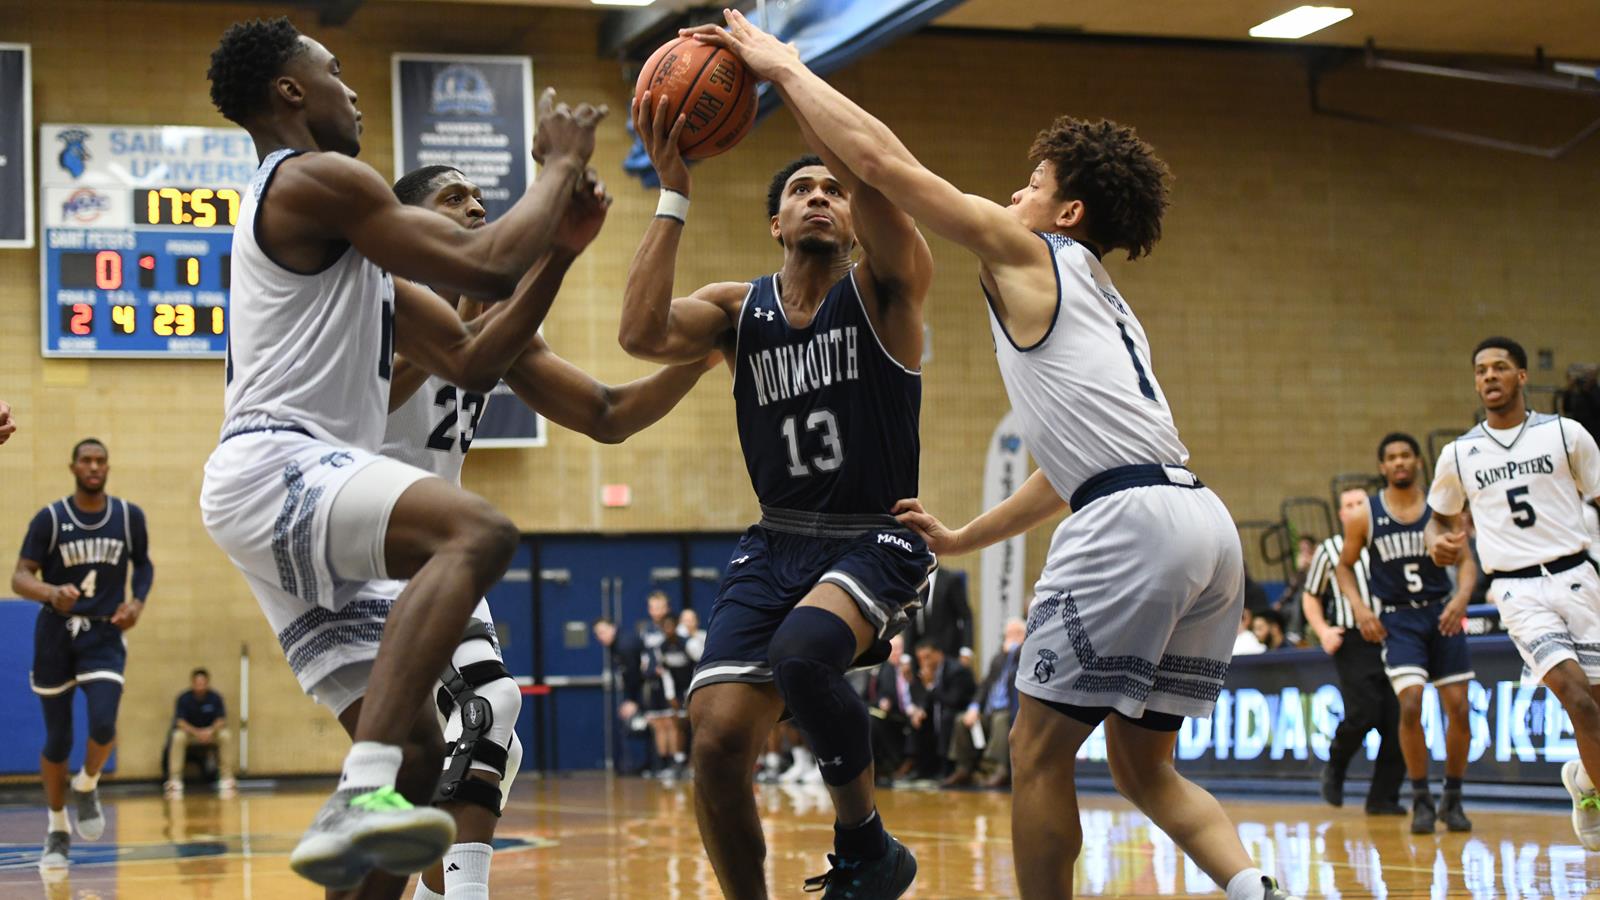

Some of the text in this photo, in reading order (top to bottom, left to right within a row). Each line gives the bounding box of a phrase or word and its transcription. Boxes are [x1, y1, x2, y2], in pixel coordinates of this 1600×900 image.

[709, 57, 737, 93] THE
[148, 188, 240, 228] 17:57
[96, 250, 122, 290] 0
[186, 257, 199, 286] 1
[70, 303, 93, 335] 2
[112, 305, 136, 334] 4
[153, 303, 224, 336] 23 1
[748, 325, 860, 407] MONMOUTH
[1116, 319, 1158, 403] 1
[426, 384, 486, 454] 23
[780, 408, 845, 478] 13
[1506, 485, 1537, 529] 5
[877, 533, 913, 553] MAAC
[1374, 530, 1429, 564] MONMOU
[80, 569, 98, 598] 4
[1403, 562, 1423, 593] 5
[1173, 684, 1346, 761] DIDAS
